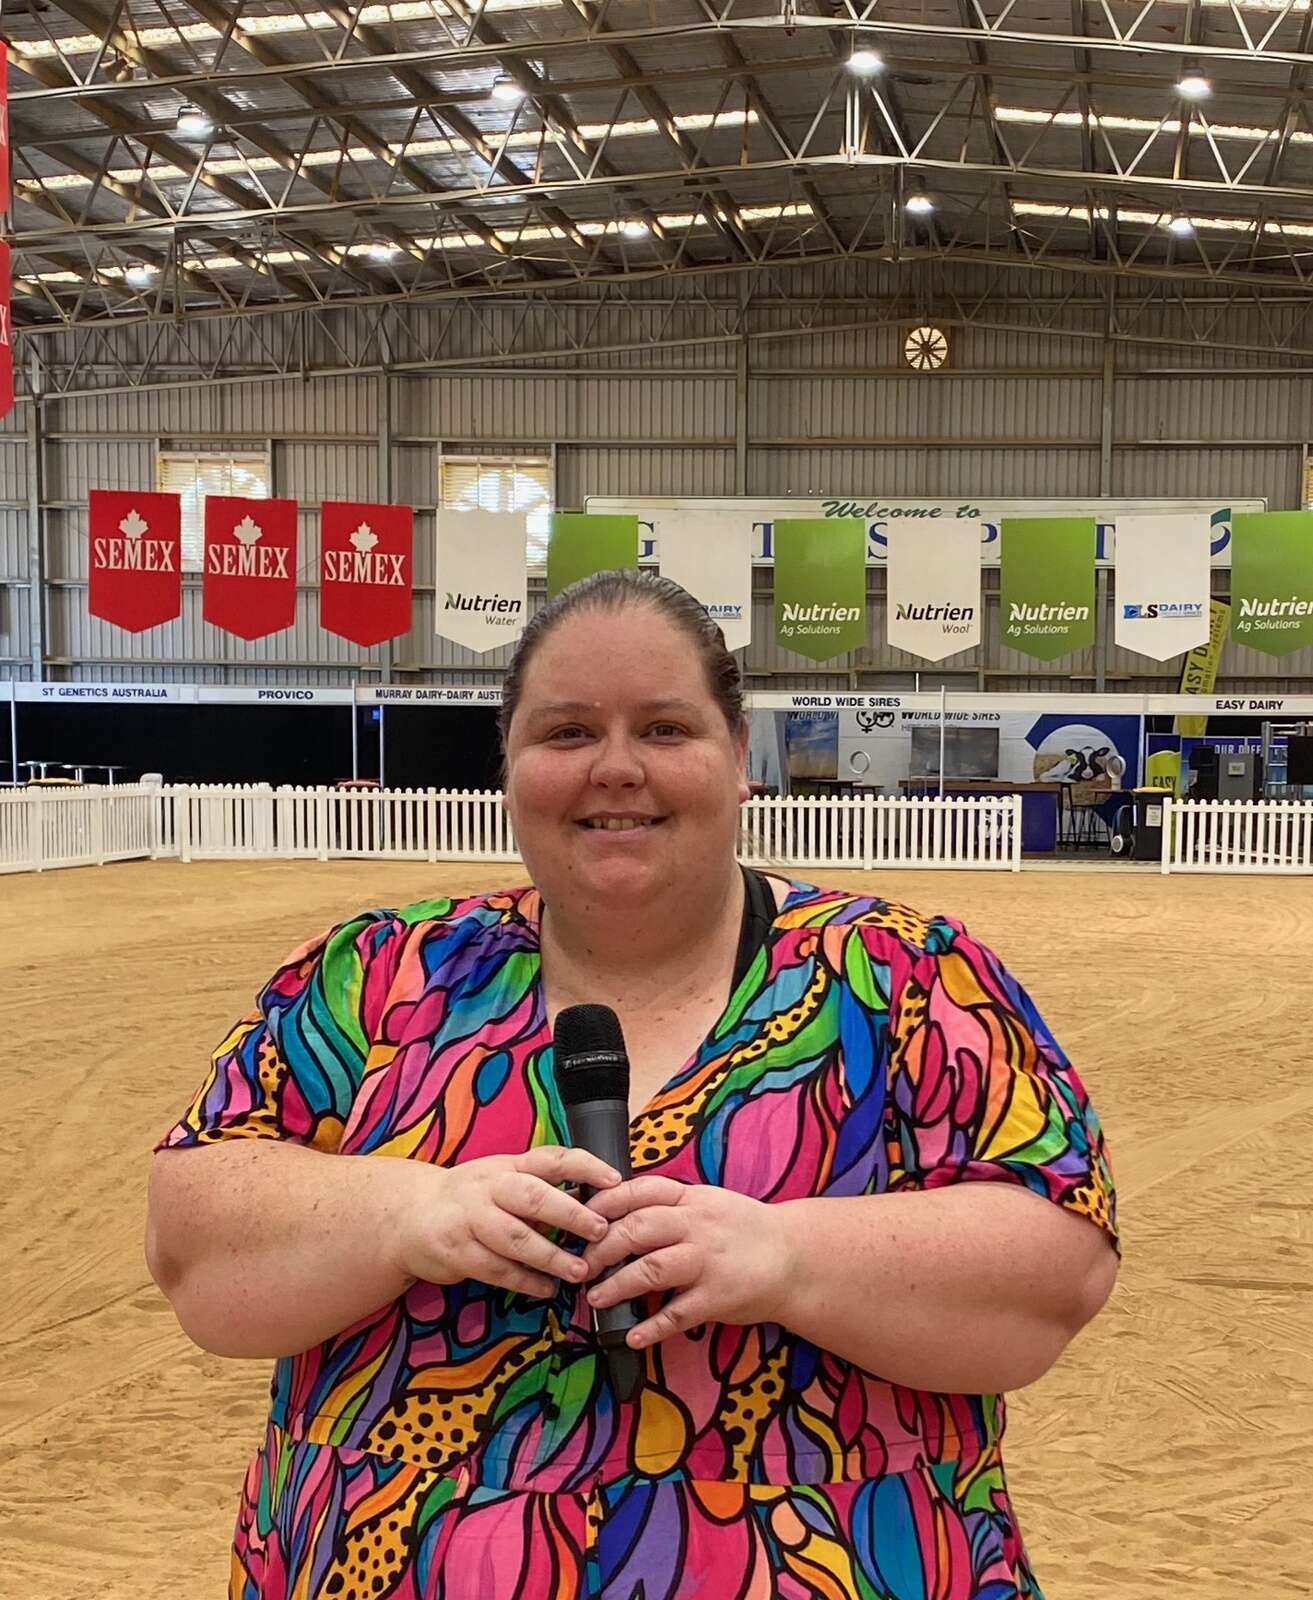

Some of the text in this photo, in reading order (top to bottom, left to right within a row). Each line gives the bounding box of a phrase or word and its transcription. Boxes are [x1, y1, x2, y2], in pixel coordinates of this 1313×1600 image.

[822, 500, 981, 519] Welcome to
[93, 538, 175, 573] SEMEX
[208, 543, 289, 579] SEMEX
[324, 551, 406, 586] SEMEX
[444, 592, 521, 612] Nutrien
[1159, 603, 1202, 612] DAIRY
[781, 603, 860, 622] Nutrien
[896, 603, 973, 622] Nutrien
[1009, 603, 1088, 622] Nutrien
[485, 615, 517, 627] Water
[1237, 620, 1301, 632] Ag Solutions
[780, 625, 840, 637] Ag Solutions
[942, 625, 970, 634] Wool
[1008, 625, 1069, 637] Ag Solutions
[1185, 661, 1203, 694] ASY
[42, 688, 167, 698] ST GENETICS AUSTRALIA
[258, 690, 313, 700] PROVICO
[376, 690, 412, 700] MURRAY
[417, 690, 473, 700] DAIRY-DAIRY
[792, 697, 900, 707] WORLD WIDE SIRES
[1216, 698, 1284, 709] EASY DAIRY
